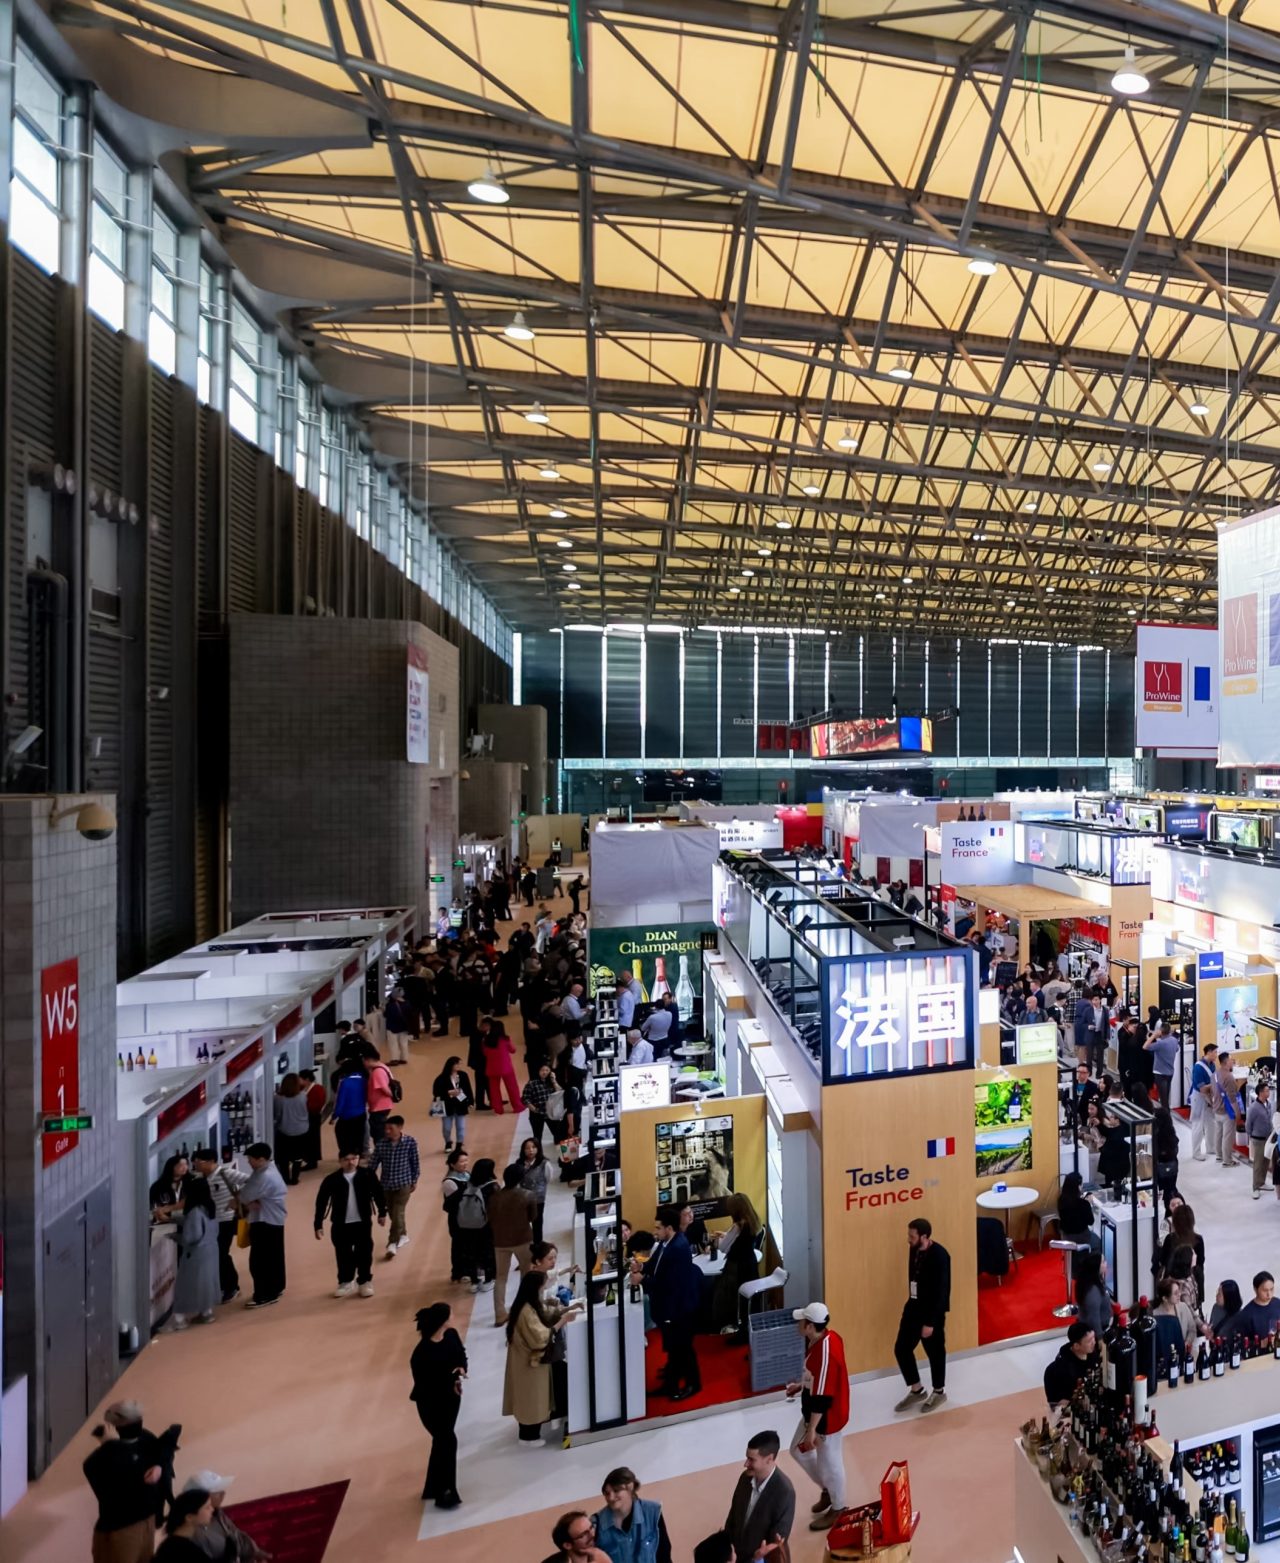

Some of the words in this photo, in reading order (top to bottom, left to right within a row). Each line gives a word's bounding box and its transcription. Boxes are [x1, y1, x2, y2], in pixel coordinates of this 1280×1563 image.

[1224, 656, 1256, 673] ProWine
[1145, 692, 1181, 701] ProWine
[952, 837, 982, 847] Taste
[952, 848, 988, 858] France
[1119, 921, 1143, 930] Taste
[645, 931, 677, 942] DIAN
[1118, 931, 1140, 939] Fran
[619, 940, 702, 955] Champagne
[45, 984, 77, 1040] W5
[835, 982, 965, 1050] 法国
[57, 1084, 65, 1117] 1
[55, 1136, 69, 1153] Gate
[846, 1164, 909, 1187] Taste
[845, 1186, 923, 1211] France
